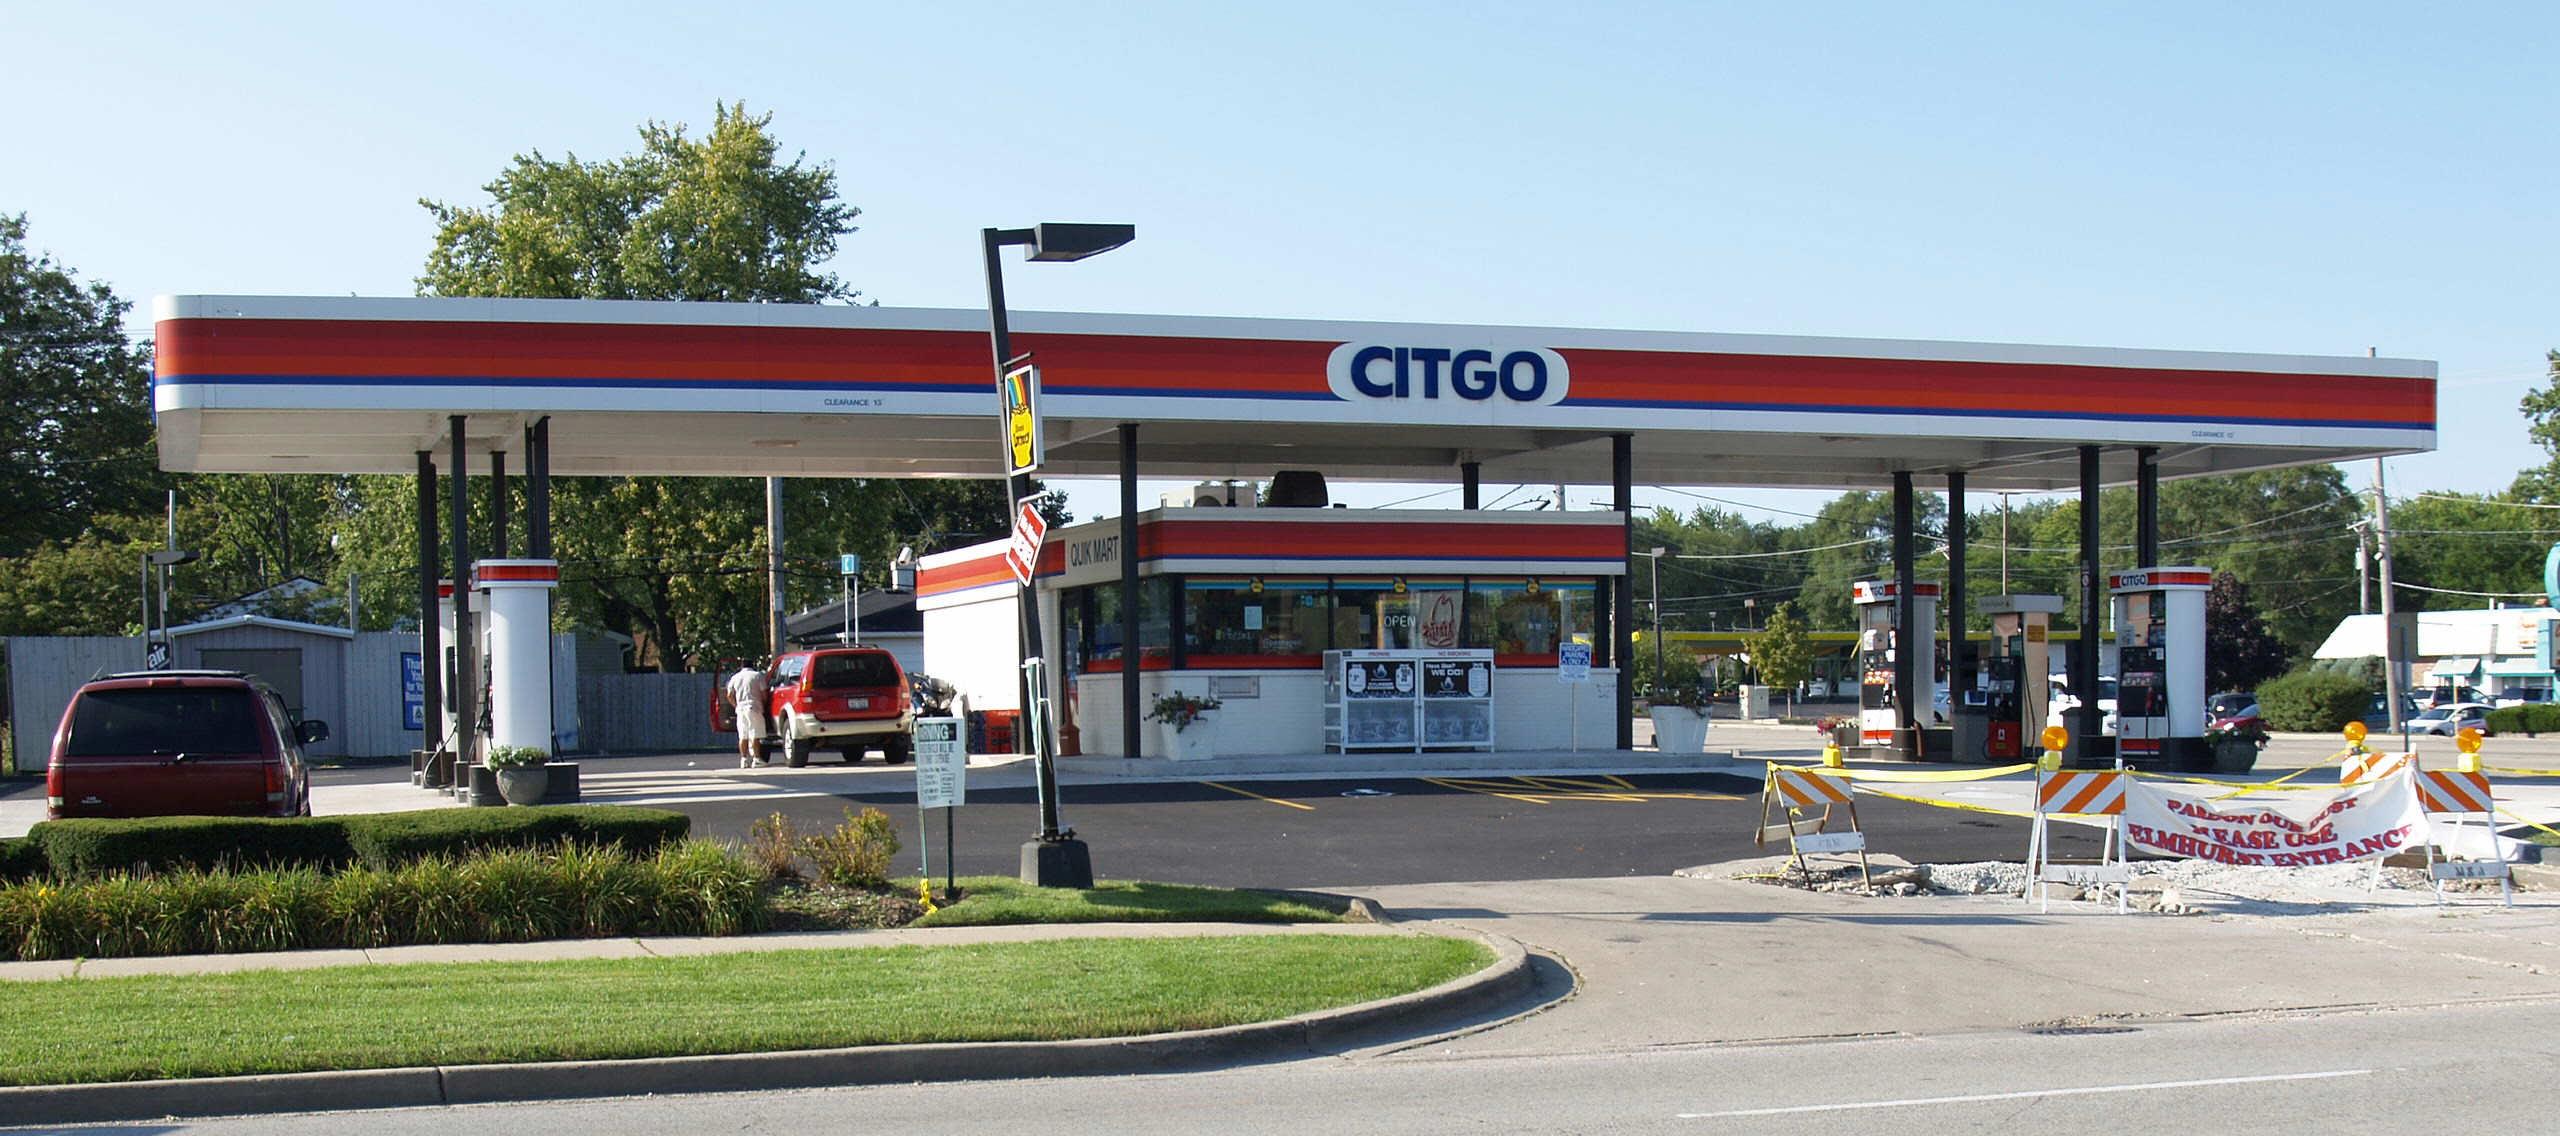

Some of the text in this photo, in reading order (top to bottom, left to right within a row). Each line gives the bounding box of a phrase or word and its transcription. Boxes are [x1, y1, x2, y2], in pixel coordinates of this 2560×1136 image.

[1350, 346, 1548, 401] CITGO
[1070, 535, 1119, 567] QUIK MART
[2121, 575, 2146, 586] CITGO
[1384, 615, 1415, 628] OPEN
[148, 644, 165, 668] air
[2167, 797, 2358, 833] PARDON OUR DUST
[2127, 823, 2264, 866] ELMHURST
[2285, 822, 2338, 848] USE
